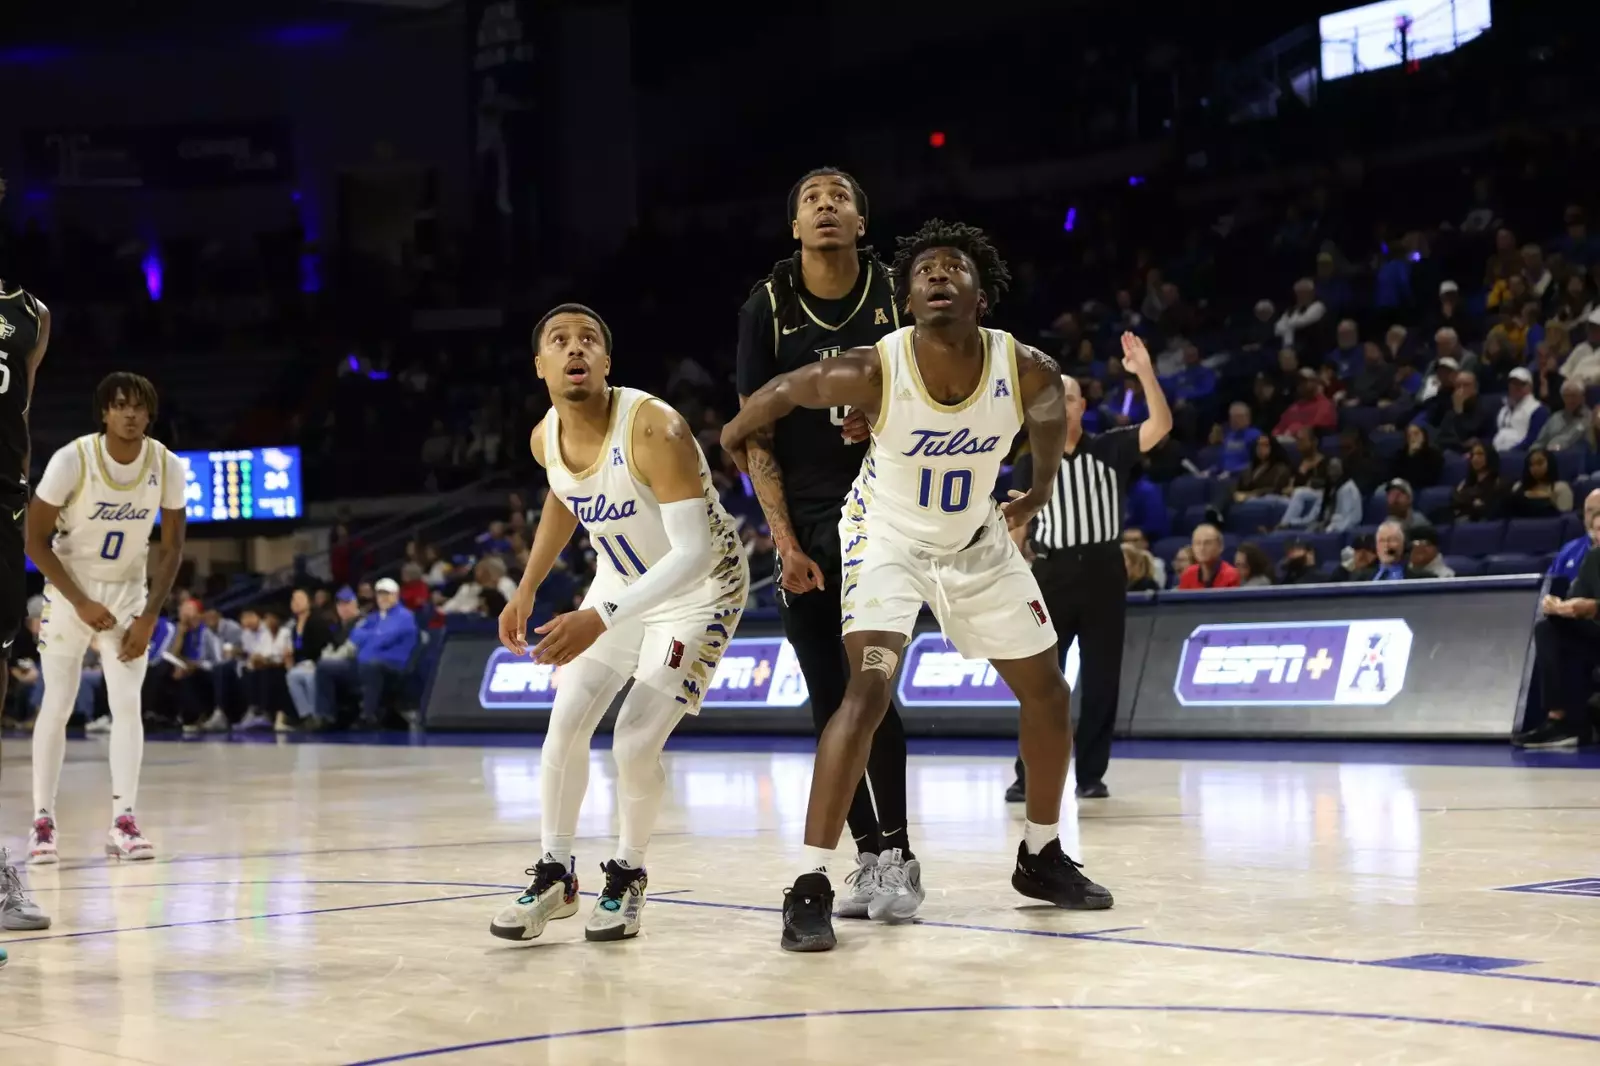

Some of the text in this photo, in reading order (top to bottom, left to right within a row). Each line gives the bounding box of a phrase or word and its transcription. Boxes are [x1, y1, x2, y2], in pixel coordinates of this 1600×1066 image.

[902, 428, 1001, 457] Tulsa
[916, 466, 974, 515] 10
[87, 502, 150, 521] Tulsa
[566, 493, 637, 523] Tulsa
[101, 531, 125, 560] 0
[594, 533, 649, 585] 11
[1192, 644, 1333, 684] ESPN+
